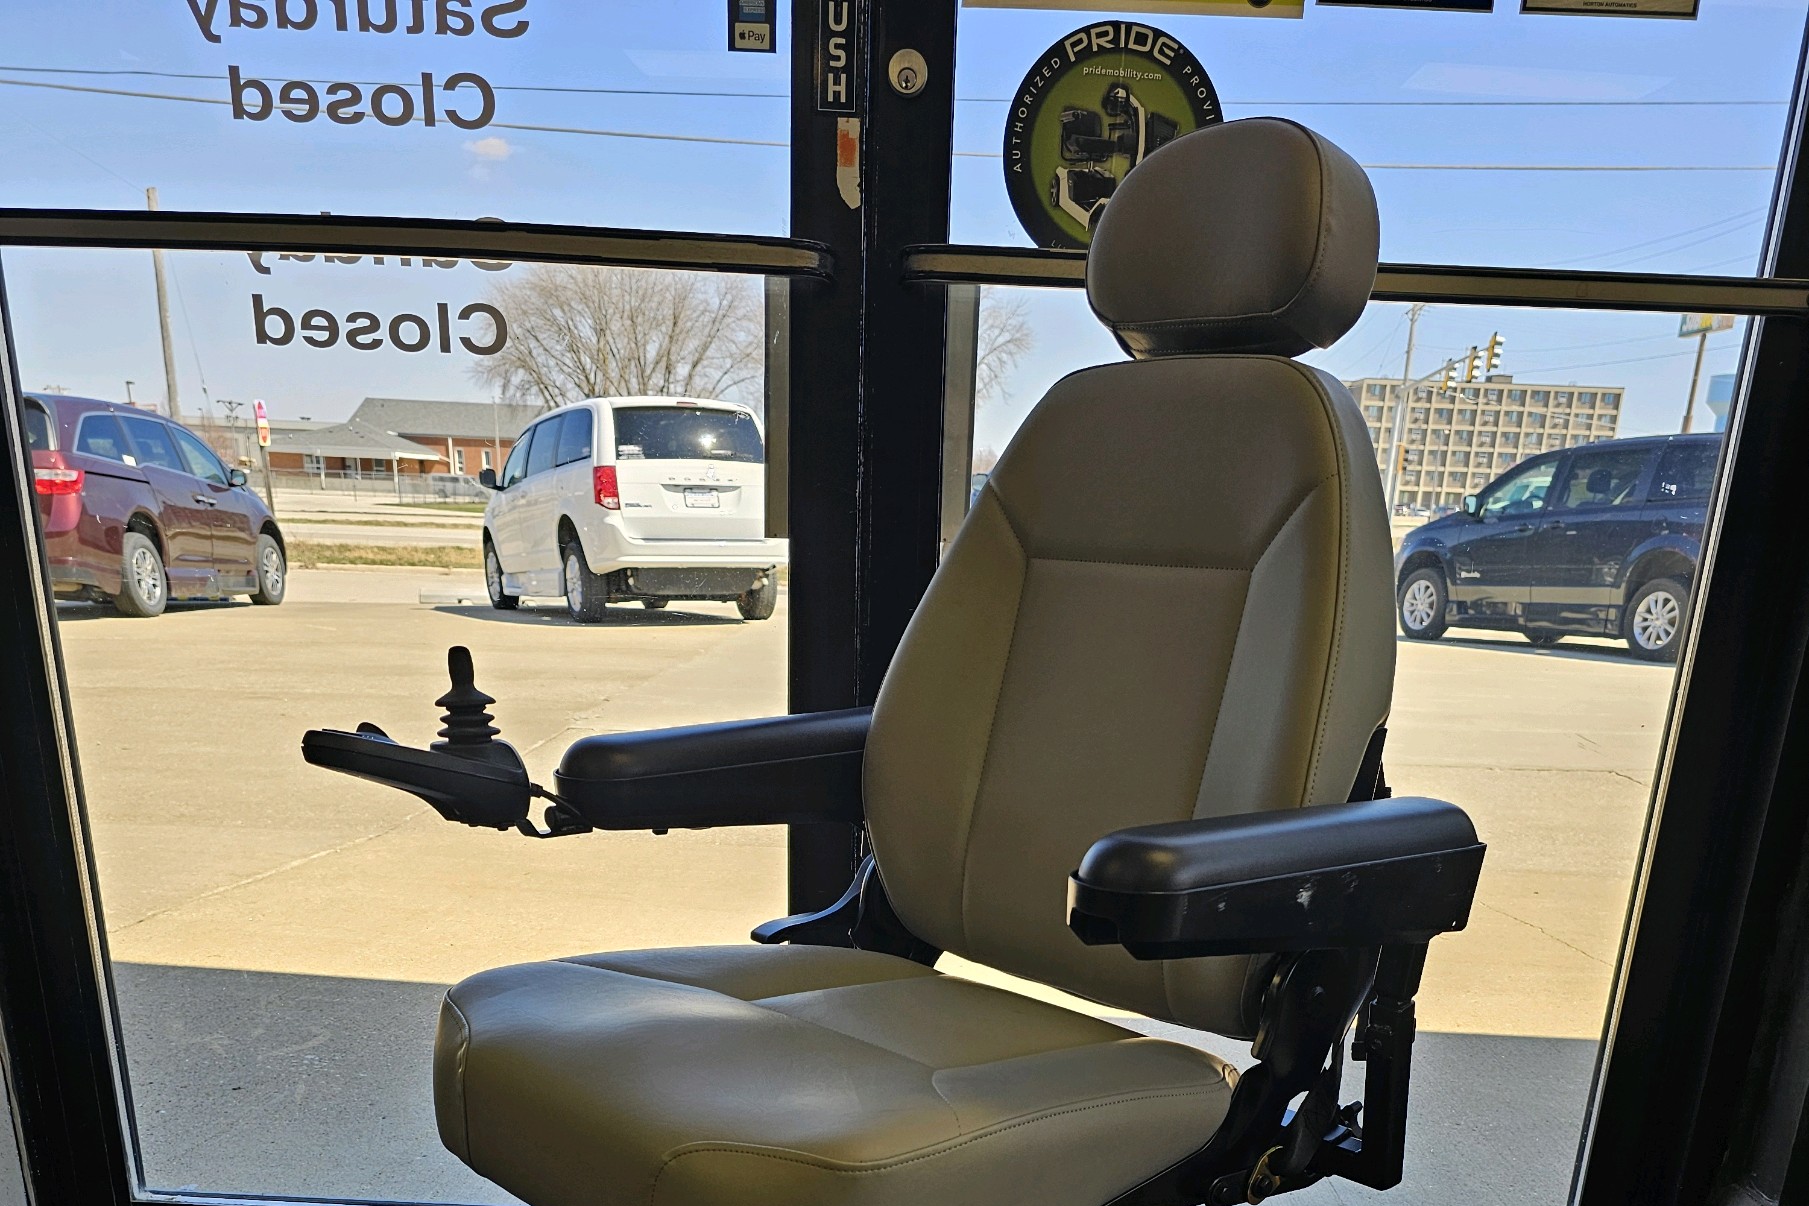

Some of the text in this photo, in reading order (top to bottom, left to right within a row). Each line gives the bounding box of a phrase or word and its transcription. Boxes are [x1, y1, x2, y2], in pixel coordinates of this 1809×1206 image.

[748, 30, 766, 44] Pay
[827, 1, 848, 103] USH
[1012, 24, 1215, 173] AUTHORIZED PRIDE PROVI
[1083, 66, 1162, 81] pridemobility.com
